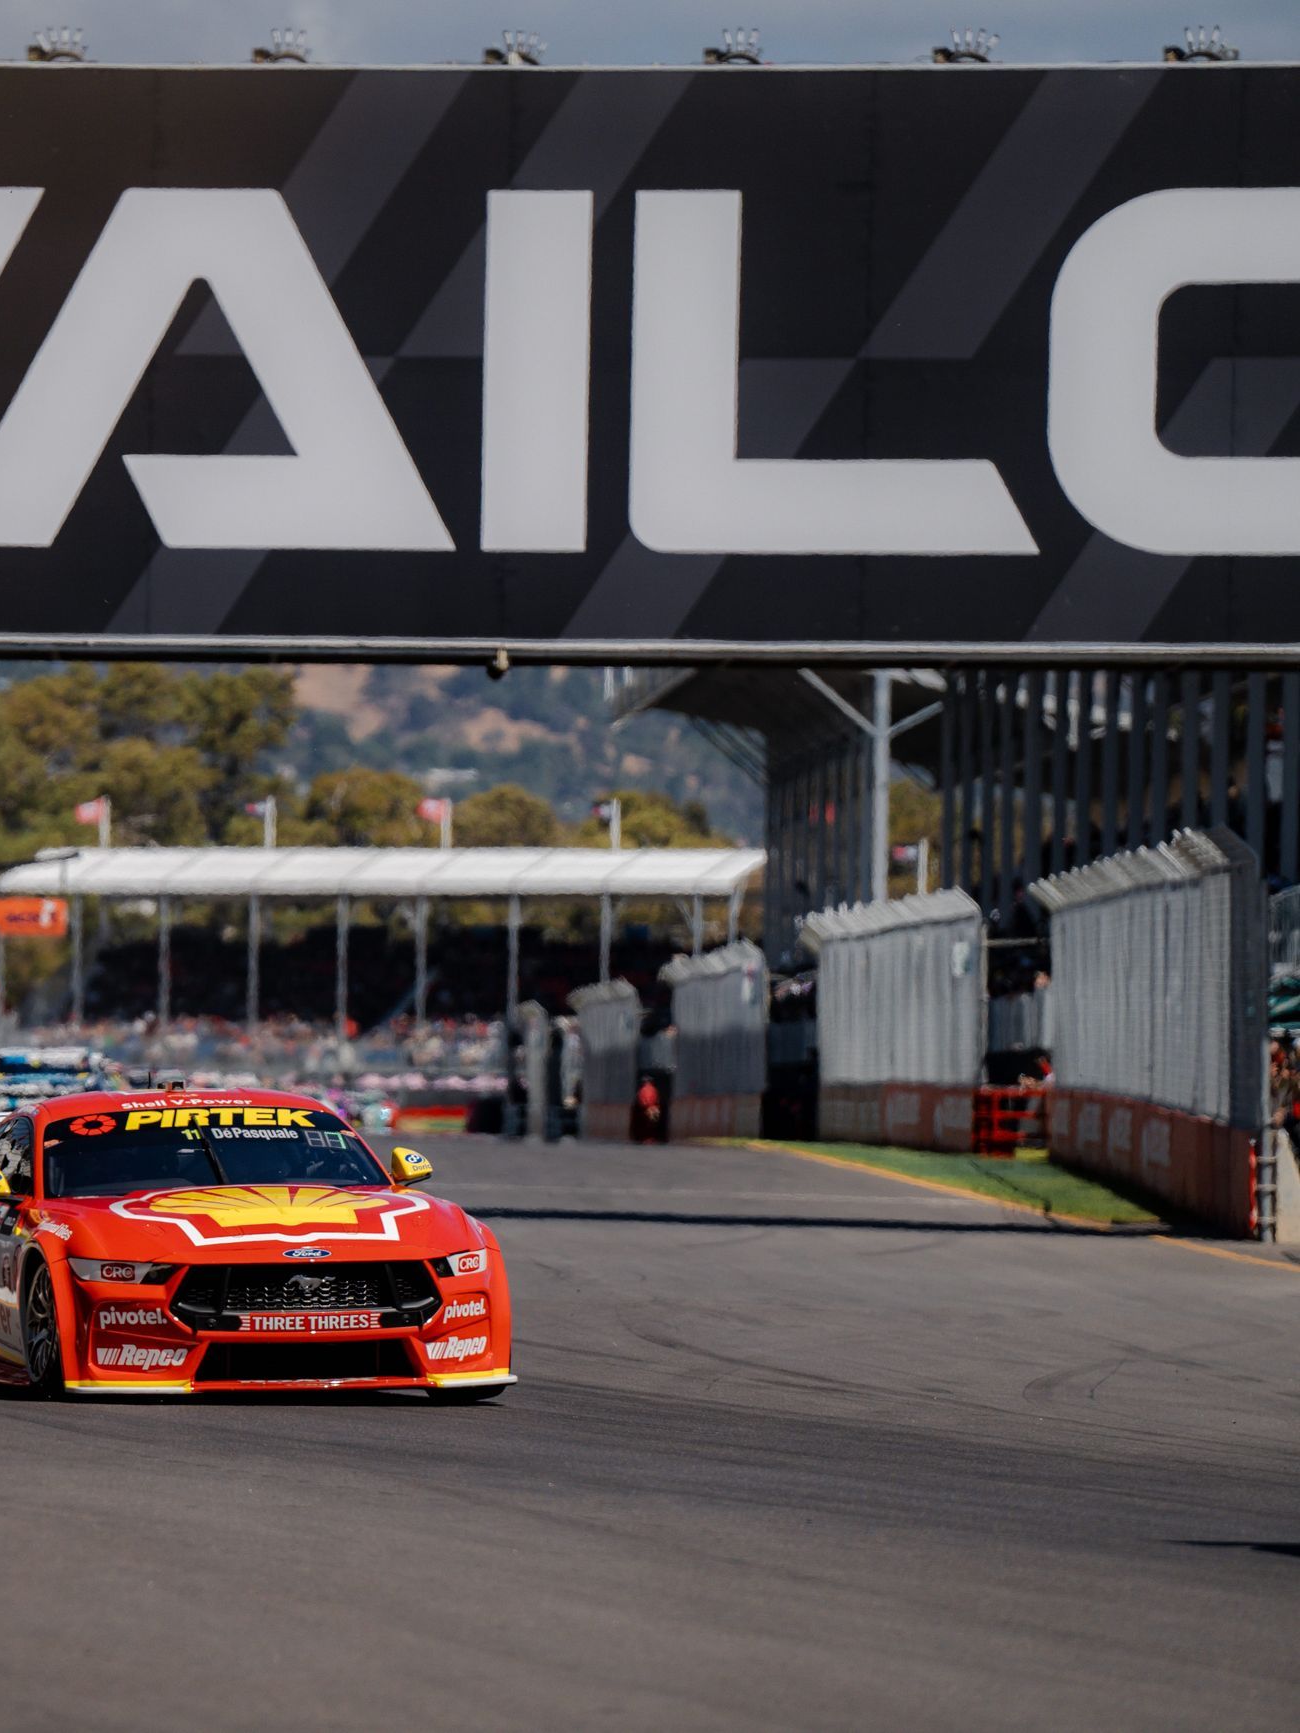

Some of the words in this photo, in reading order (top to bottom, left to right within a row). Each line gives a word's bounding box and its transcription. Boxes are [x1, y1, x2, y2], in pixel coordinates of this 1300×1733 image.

[120, 1099, 167, 1111] Shell
[170, 1098, 253, 1107] V-Power
[125, 1107, 316, 1131] PIRTEK
[292, 1249, 322, 1258] Ford
[459, 1255, 480, 1271] CRC
[102, 1265, 134, 1280] CRC
[100, 1306, 168, 1330] pivotel.
[443, 1298, 487, 1325] pivotel.
[252, 1315, 305, 1331] THREE
[308, 1314, 370, 1330] THREES
[118, 1343, 188, 1371] Repco
[442, 1335, 487, 1362] Repco
